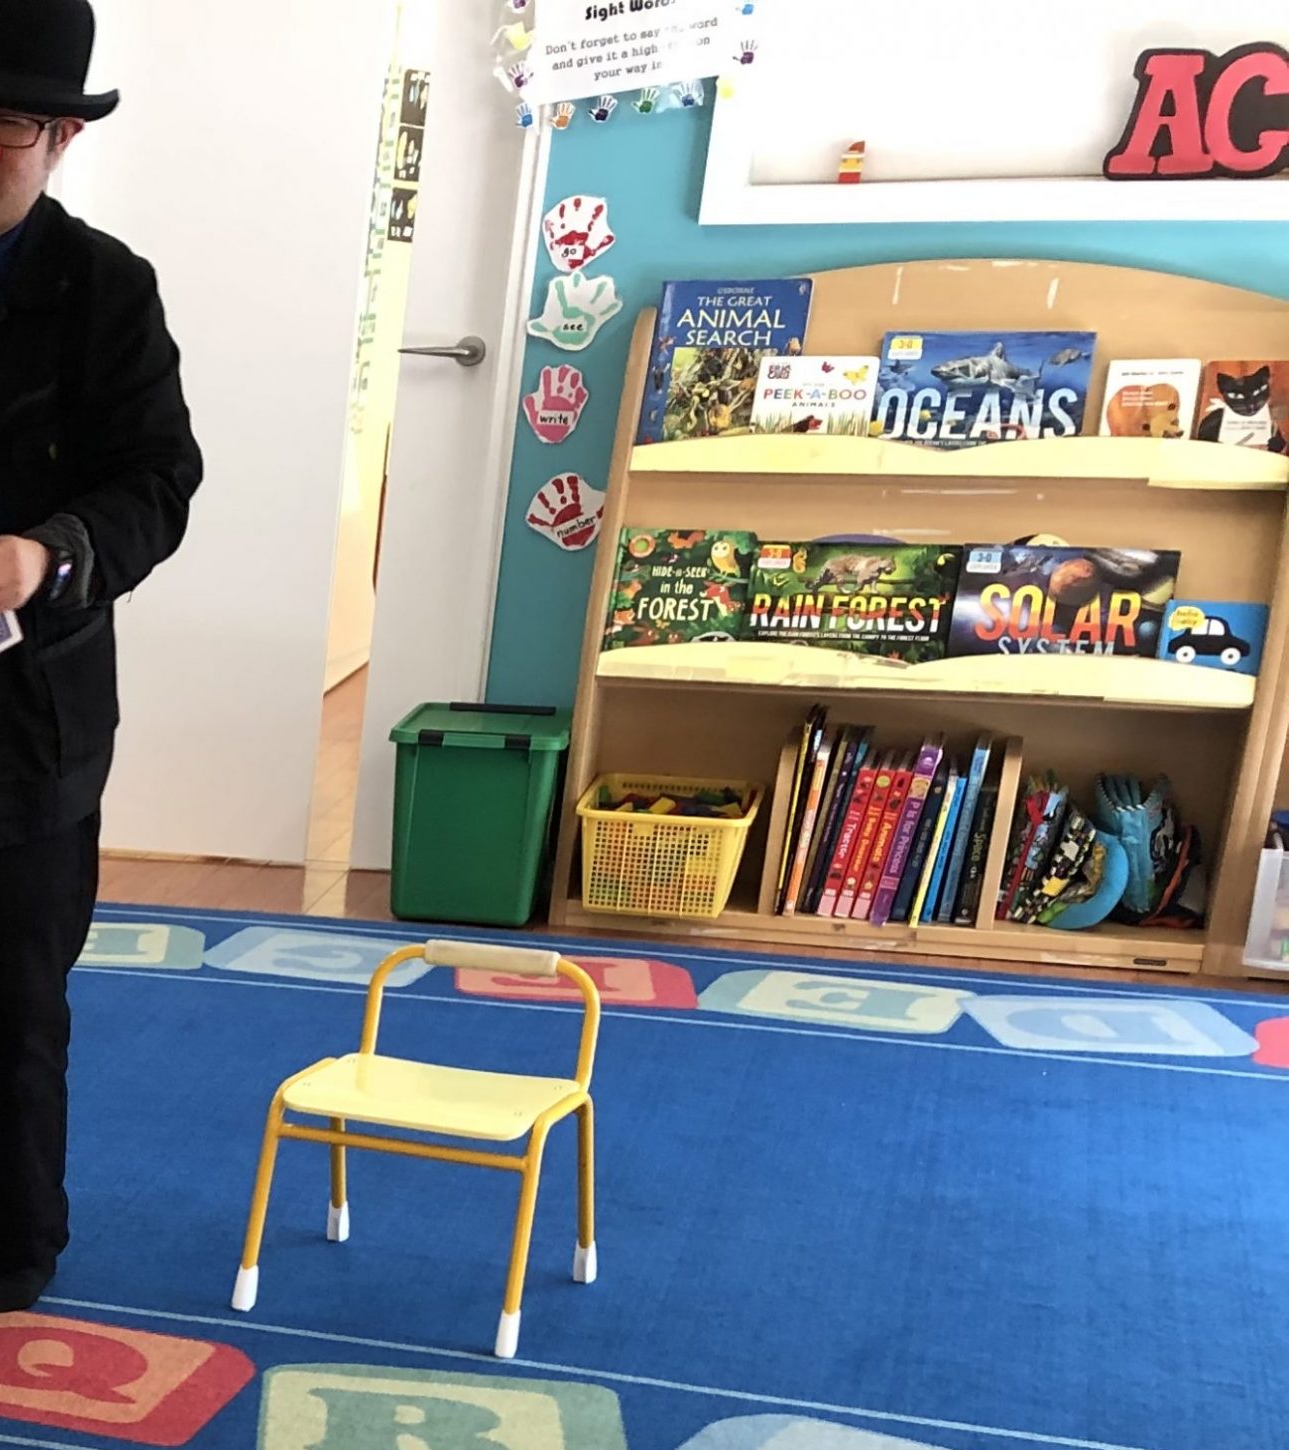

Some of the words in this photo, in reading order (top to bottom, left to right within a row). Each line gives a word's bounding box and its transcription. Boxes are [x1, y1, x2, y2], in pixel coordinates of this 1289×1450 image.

[585, 2, 625, 21] Sight
[545, 40, 577, 55] Don't
[580, 35, 620, 51] forget
[623, 32, 637, 42] to
[640, 27, 661, 40] say
[552, 58, 573, 71] and
[576, 53, 603, 68] give
[606, 51, 618, 62] it
[621, 50, 628, 59] a
[594, 66, 622, 81] your
[625, 62, 648, 76] way
[561, 247, 577, 258] go
[697, 296, 725, 307] THE
[727, 295, 773, 307] GREAT
[562, 322, 584, 331] see
[676, 308, 786, 329] ANIMAL
[685, 329, 772, 346] SEARCH
[763, 388, 867, 401] PEEK-A-BOO
[539, 413, 569, 425] write
[875, 387, 1078, 439] OCEANS
[557, 514, 596, 539] number
[660, 581, 671, 594] in
[674, 578, 694, 595] the
[637, 597, 714, 621] FOREST
[749, 593, 824, 629] RAIN
[828, 595, 947, 633] FOREST
[974, 583, 1142, 647] SOLAR
[838, 823, 858, 860] Tractor
[872, 822, 892, 863] Animals
[889, 832, 911, 875] Princess
